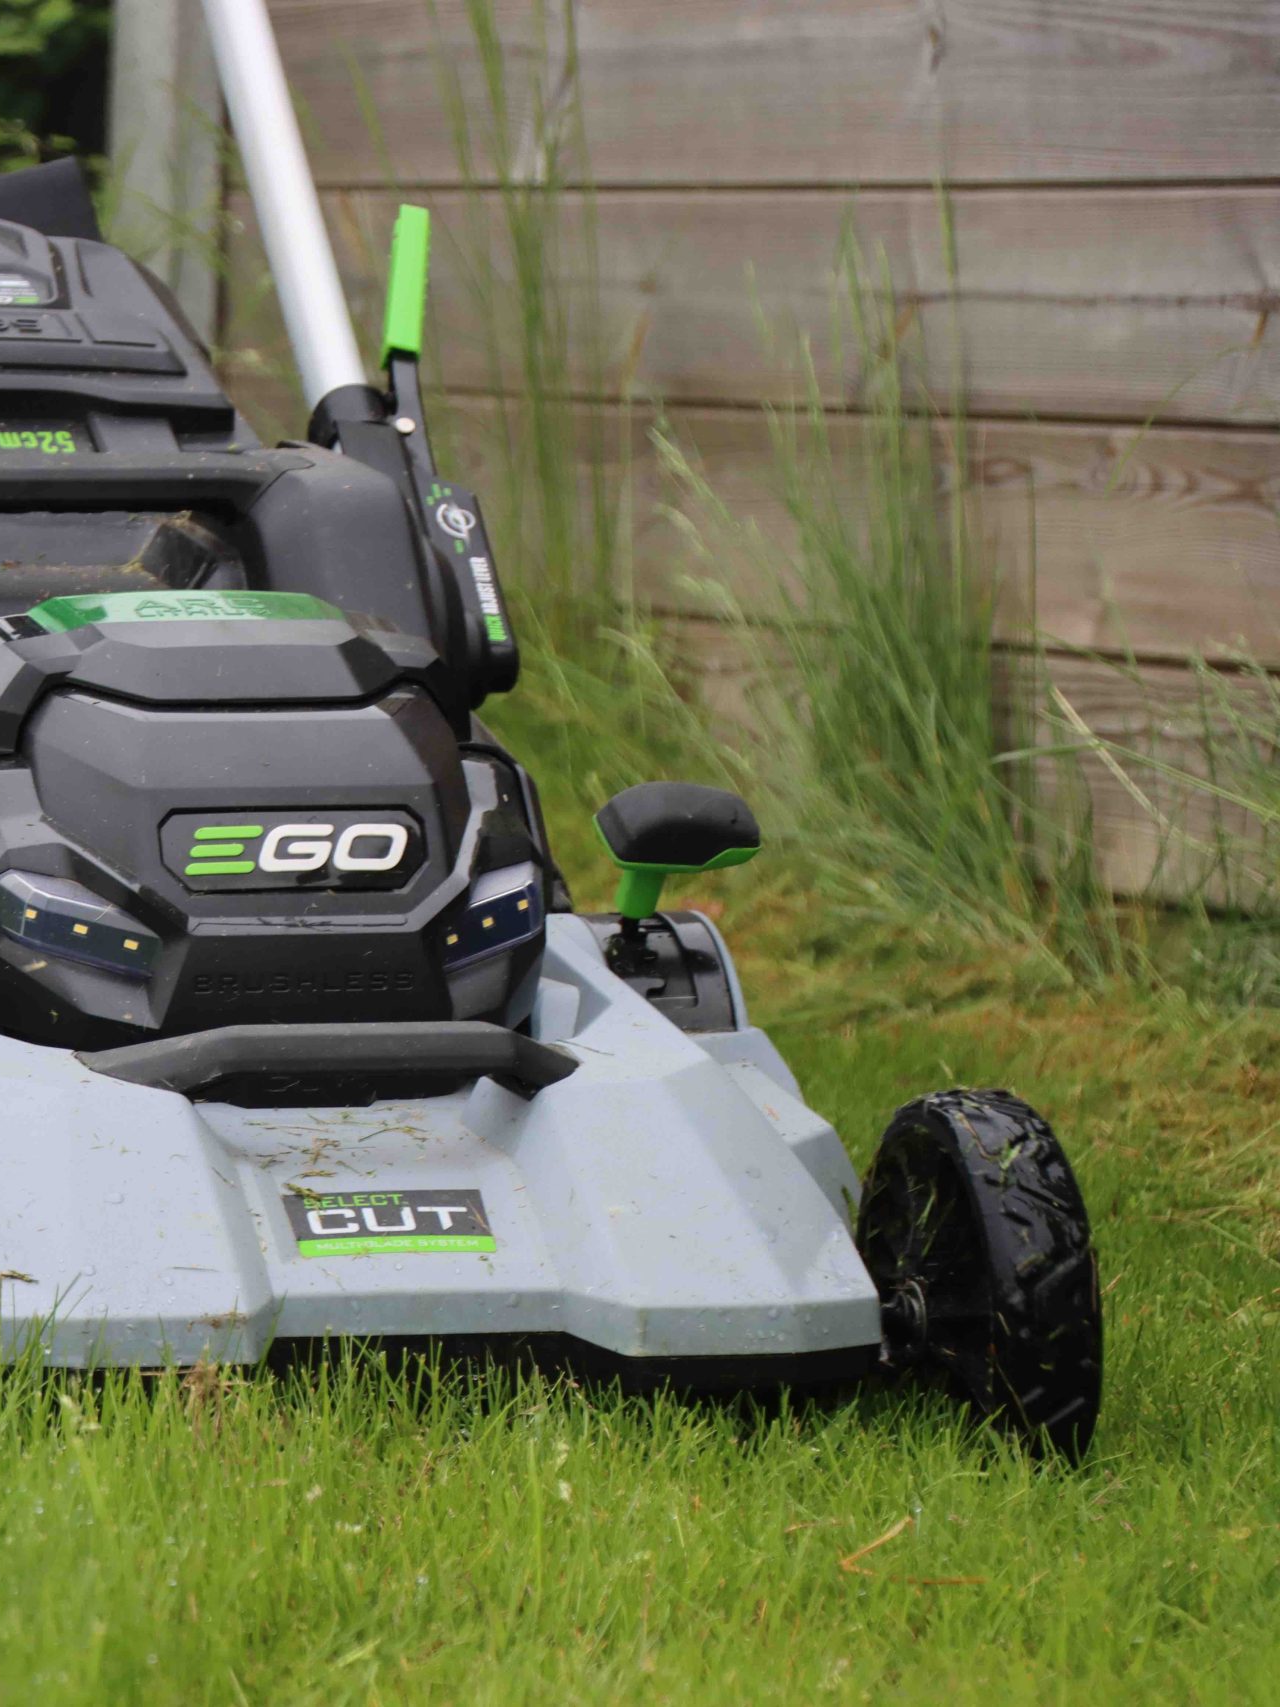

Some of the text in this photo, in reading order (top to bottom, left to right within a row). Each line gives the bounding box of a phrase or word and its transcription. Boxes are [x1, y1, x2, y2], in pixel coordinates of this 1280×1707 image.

[184, 823, 409, 876] EGO
[193, 974, 414, 996] BRUSHLESS
[303, 1193, 404, 1210] SELECT
[306, 1206, 468, 1235] CUT
